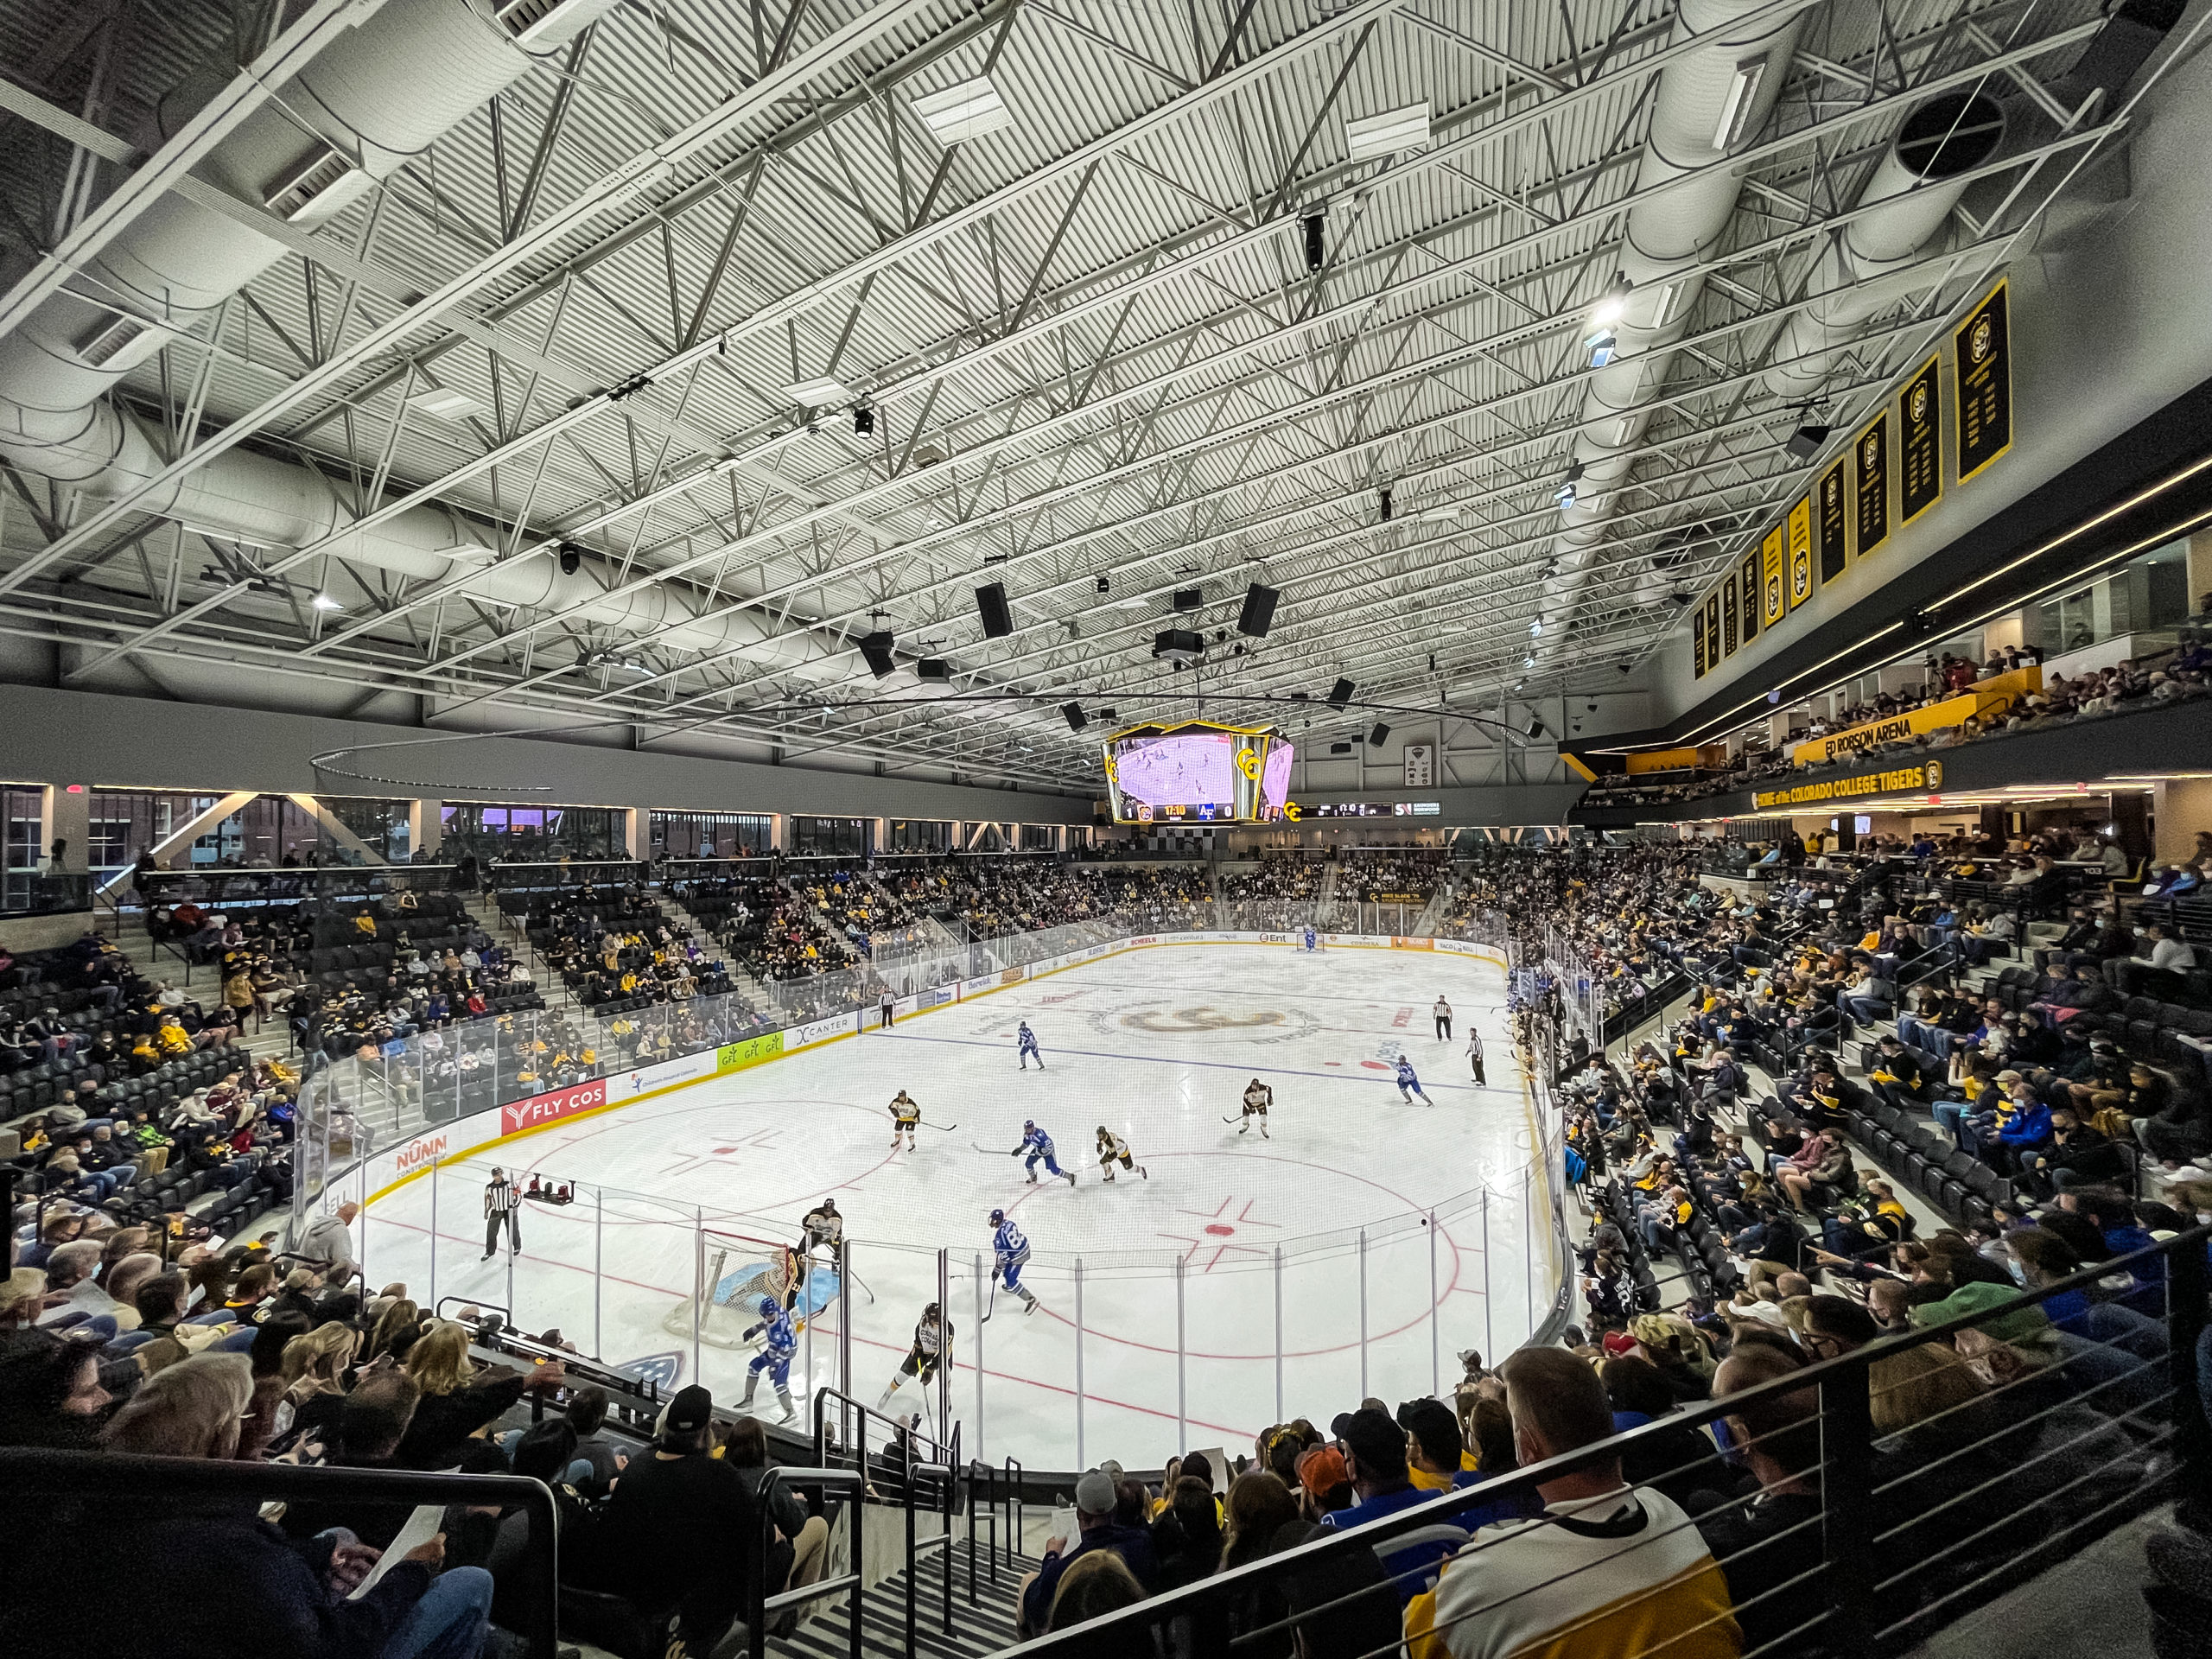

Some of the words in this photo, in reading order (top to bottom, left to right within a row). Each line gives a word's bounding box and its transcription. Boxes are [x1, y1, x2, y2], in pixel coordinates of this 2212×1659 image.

[1826, 741, 1835, 754] ED
[1838, 729, 1873, 752] ROBSON
[1876, 719, 1911, 742] ARENA
[1758, 792, 1775, 806] HOME
[1790, 781, 1833, 803] COLORADO
[1834, 775, 1878, 798] COLLEGE
[1878, 766, 1924, 791] TIGERS
[1127, 808, 1133, 818] 1
[1165, 804, 1186, 816] 17:10
[1224, 806, 1232, 817] 0
[1269, 934, 1287, 943] Ent
[810, 1020, 849, 1036] CANTER
[533, 1099, 563, 1120] FLY
[569, 1088, 602, 1109] COS
